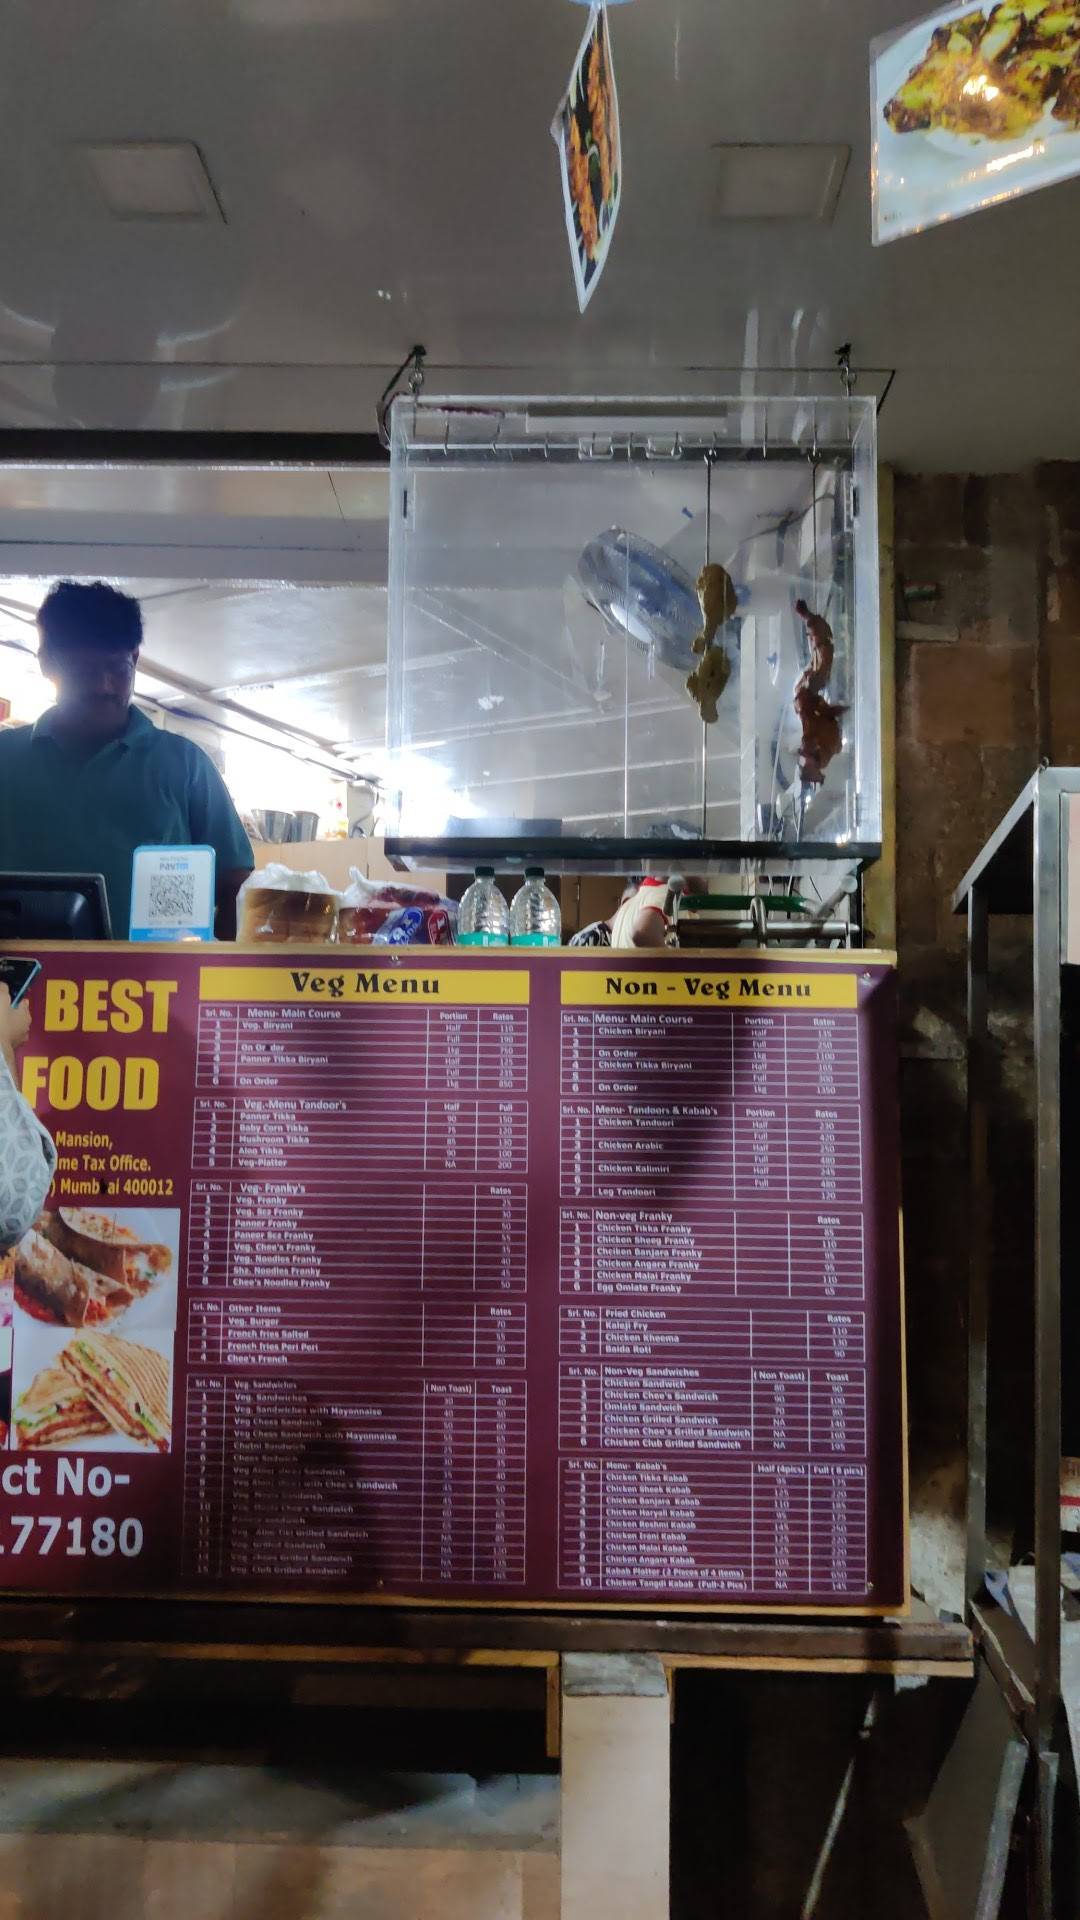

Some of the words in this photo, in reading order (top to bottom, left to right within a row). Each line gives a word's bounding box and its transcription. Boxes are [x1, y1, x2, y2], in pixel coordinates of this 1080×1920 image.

[290, 972, 345, 998] Veg
[355, 973, 440, 994] Menu
[606, 977, 657, 995] Non
[684, 978, 730, 1000] Veg
[739, 978, 811, 997] Menu
[44, 979, 178, 1033] BEST
[281, 1009, 306, 1019] Main
[308, 1009, 341, 1019] Course
[440, 1012, 468, 1020] Portion
[630, 1014, 656, 1024] Main
[659, 1015, 693, 1024] Course
[744, 1017, 774, 1026] Portion
[598, 1027, 632, 1035] Chicken
[635, 1028, 666, 1037] Biryani
[598, 1050, 610, 1058] On
[613, 1050, 638, 1058] Order
[273, 1056, 296, 1064] Tikka
[598, 1061, 632, 1069] Chicken
[661, 1062, 692, 1071] Biryani
[21, 1055, 159, 1111] FOOD
[240, 1077, 252, 1085] On
[598, 1084, 611, 1092] On
[613, 1084, 638, 1092] Order
[444, 1103, 460, 1111] Half
[672, 1106, 680, 1115] &
[273, 1113, 295, 1121] Tikka
[746, 1108, 776, 1117] Portion
[815, 1110, 838, 1118] Rates
[598, 1119, 632, 1127] Chicken
[239, 1124, 260, 1134] Baby
[55, 1131, 113, 1150] Mansion,
[286, 1136, 310, 1144] Tikka
[598, 1141, 633, 1150] Chicken
[82, 1155, 105, 1171] Tax
[109, 1154, 151, 1172] Office.
[123, 1179, 174, 1196] 400012
[265, 1183, 306, 1194] Franky's
[490, 1187, 511, 1195] Rates
[257, 1197, 287, 1205] Franky
[595, 1211, 636, 1222] Non-veg
[639, 1212, 672, 1223] Franky
[817, 1216, 840, 1225] Rates
[268, 1220, 297, 1229] Franky
[597, 1224, 632, 1232] Chicken
[634, 1224, 658, 1233] Tikka
[661, 1225, 691, 1234] Franky
[286, 1244, 315, 1253] Franky
[292, 1255, 321, 1265] Franky
[597, 1271, 632, 1279] Chicken
[661, 1272, 691, 1281] Franky
[301, 1279, 330, 1289] Franky
[597, 1283, 613, 1293] Egg
[651, 1284, 681, 1293] Franky
[228, 1304, 253, 1313] Other
[256, 1304, 281, 1313] Items
[490, 1307, 511, 1316] Rates
[606, 1310, 628, 1319] Fried
[631, 1311, 666, 1319] Chicken
[827, 1314, 851, 1323] Rates
[250, 1318, 279, 1327] Burger
[228, 1330, 257, 1338] French
[606, 1334, 641, 1343] Chicken
[227, 1342, 257, 1351] French
[633, 1346, 651, 1354] Roti
[258, 1355, 288, 1364] French
[646, 1368, 699, 1377] Sandwiches
[825, 1373, 849, 1382] Toast
[605, 1380, 640, 1388] Chicken
[642, 1380, 686, 1389] Sandwich
[491, 1385, 512, 1394] Toast
[605, 1392, 640, 1400] Chicken
[675, 1392, 718, 1401] Sandwich
[639, 1403, 683, 1412] Sandwich
[604, 1415, 640, 1423] Chicken
[675, 1416, 718, 1425] Sandwich
[604, 1427, 640, 1435] Chicken
[706, 1428, 751, 1437] Sandwich
[697, 1440, 741, 1449] Sandwich
[56, 1457, 130, 1497] No-
[606, 1473, 637, 1481] Chicken
[663, 1474, 688, 1482] Kabab
